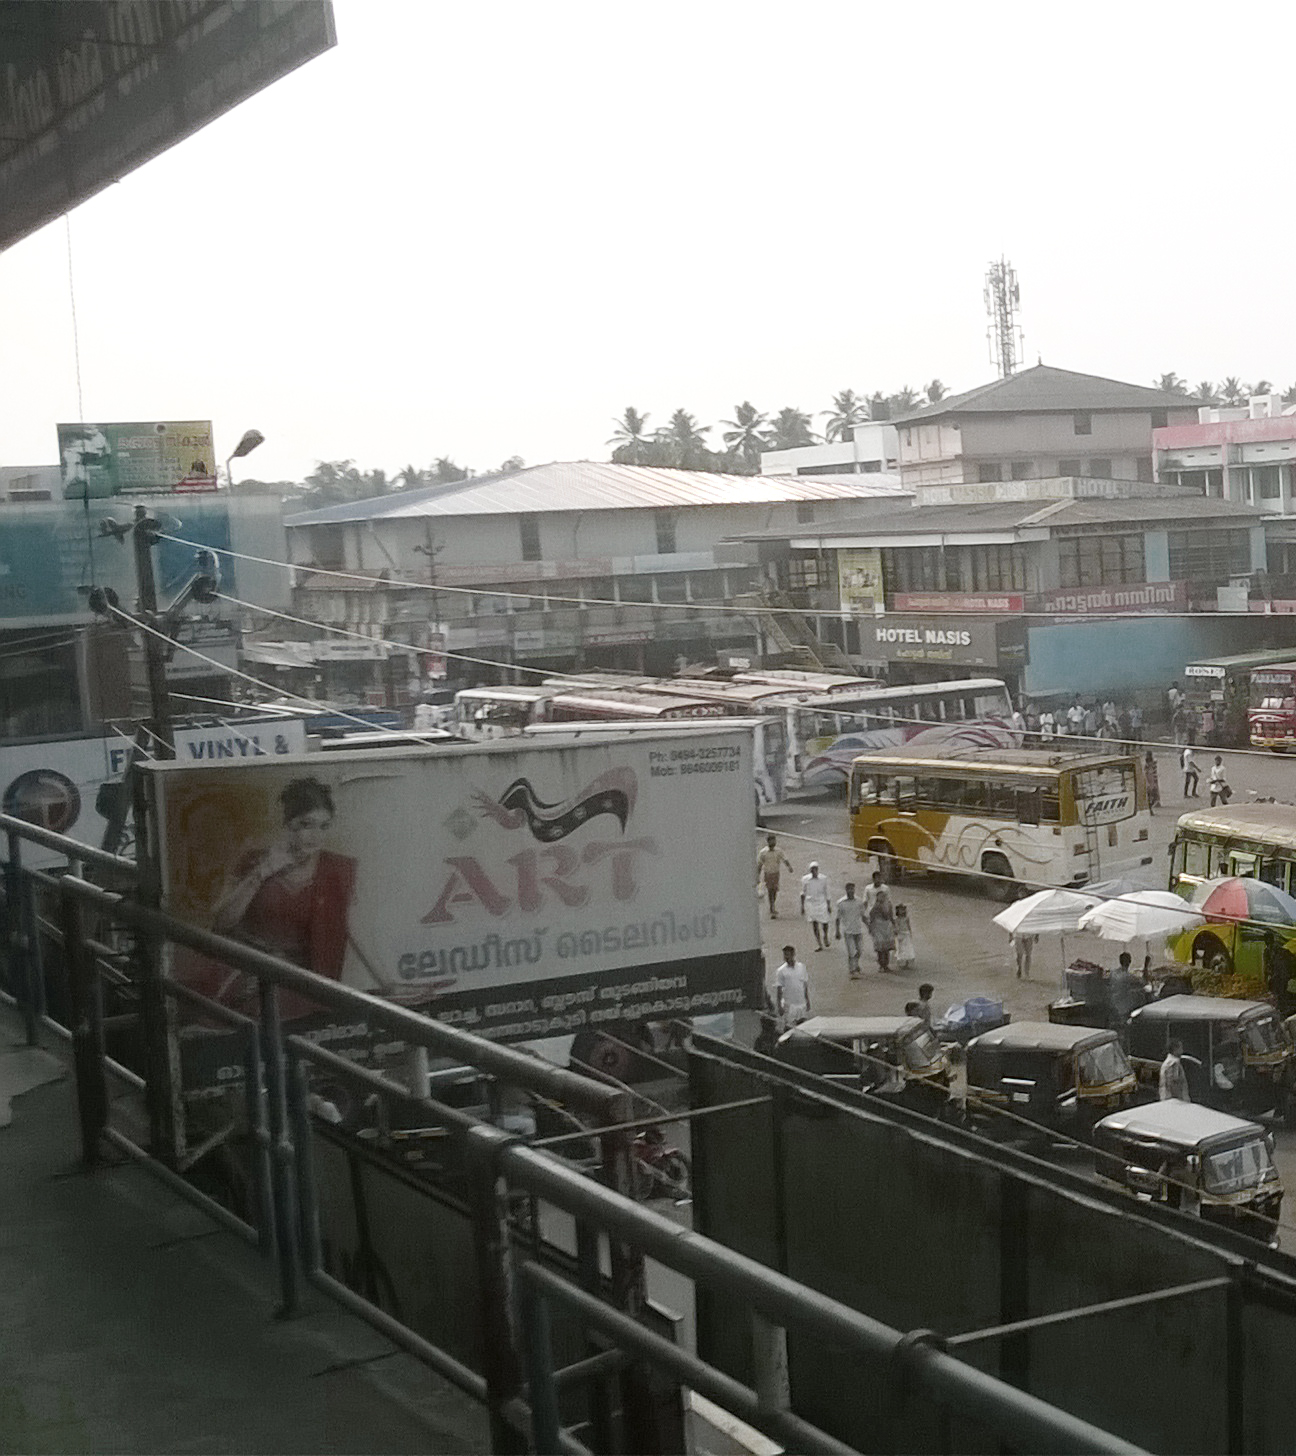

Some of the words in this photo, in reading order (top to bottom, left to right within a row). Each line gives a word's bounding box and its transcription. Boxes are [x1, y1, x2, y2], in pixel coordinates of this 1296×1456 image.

[876, 628, 923, 643] HOTEL
[925, 629, 971, 645] NASIS
[188, 736, 264, 760] VINYL
[274, 734, 290, 754] &
[1085, 796, 1128, 814] FAITH
[419, 836, 658, 925] ART
